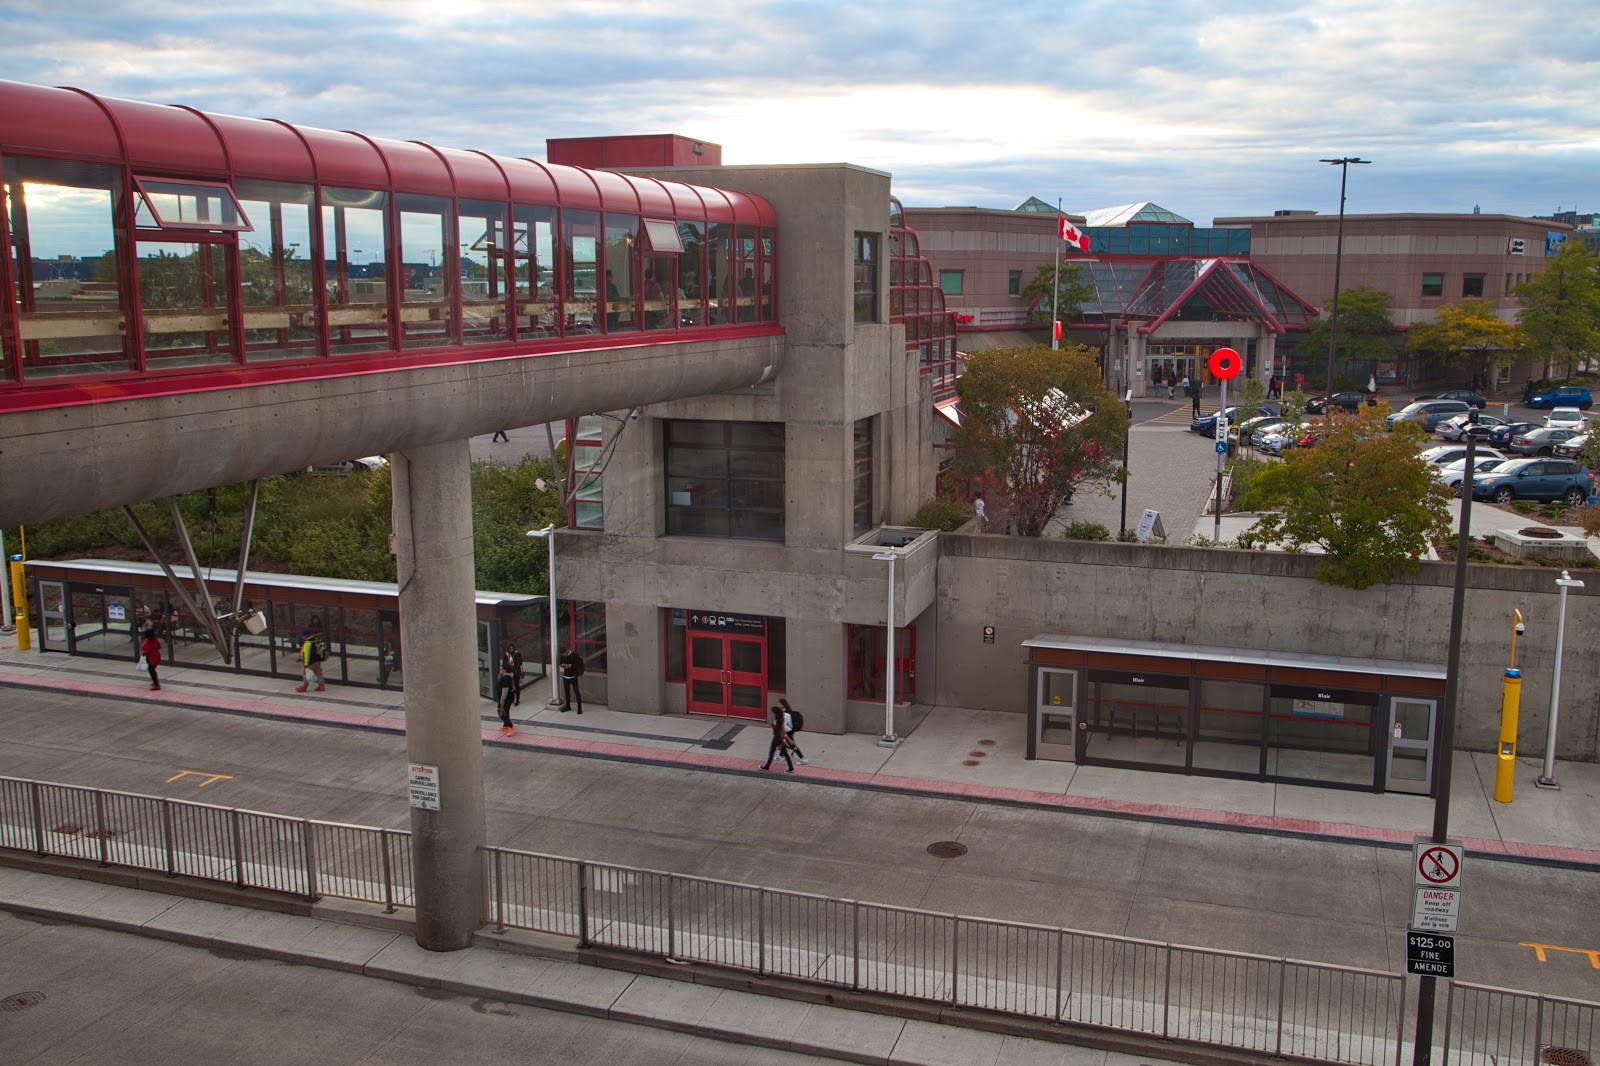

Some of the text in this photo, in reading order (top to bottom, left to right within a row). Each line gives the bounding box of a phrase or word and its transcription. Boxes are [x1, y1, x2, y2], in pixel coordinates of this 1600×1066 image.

[409, 779, 437, 788] SURVEILLANCE
[410, 789, 437, 798] SURVEILLANCE
[1423, 891, 1454, 901] DANGER
[1424, 906, 1450, 914] roadway
[1423, 915, 1448, 923] N'utilisez
[1420, 950, 1440, 960] FINE
[1413, 961, 1448, 973] AMENDE
